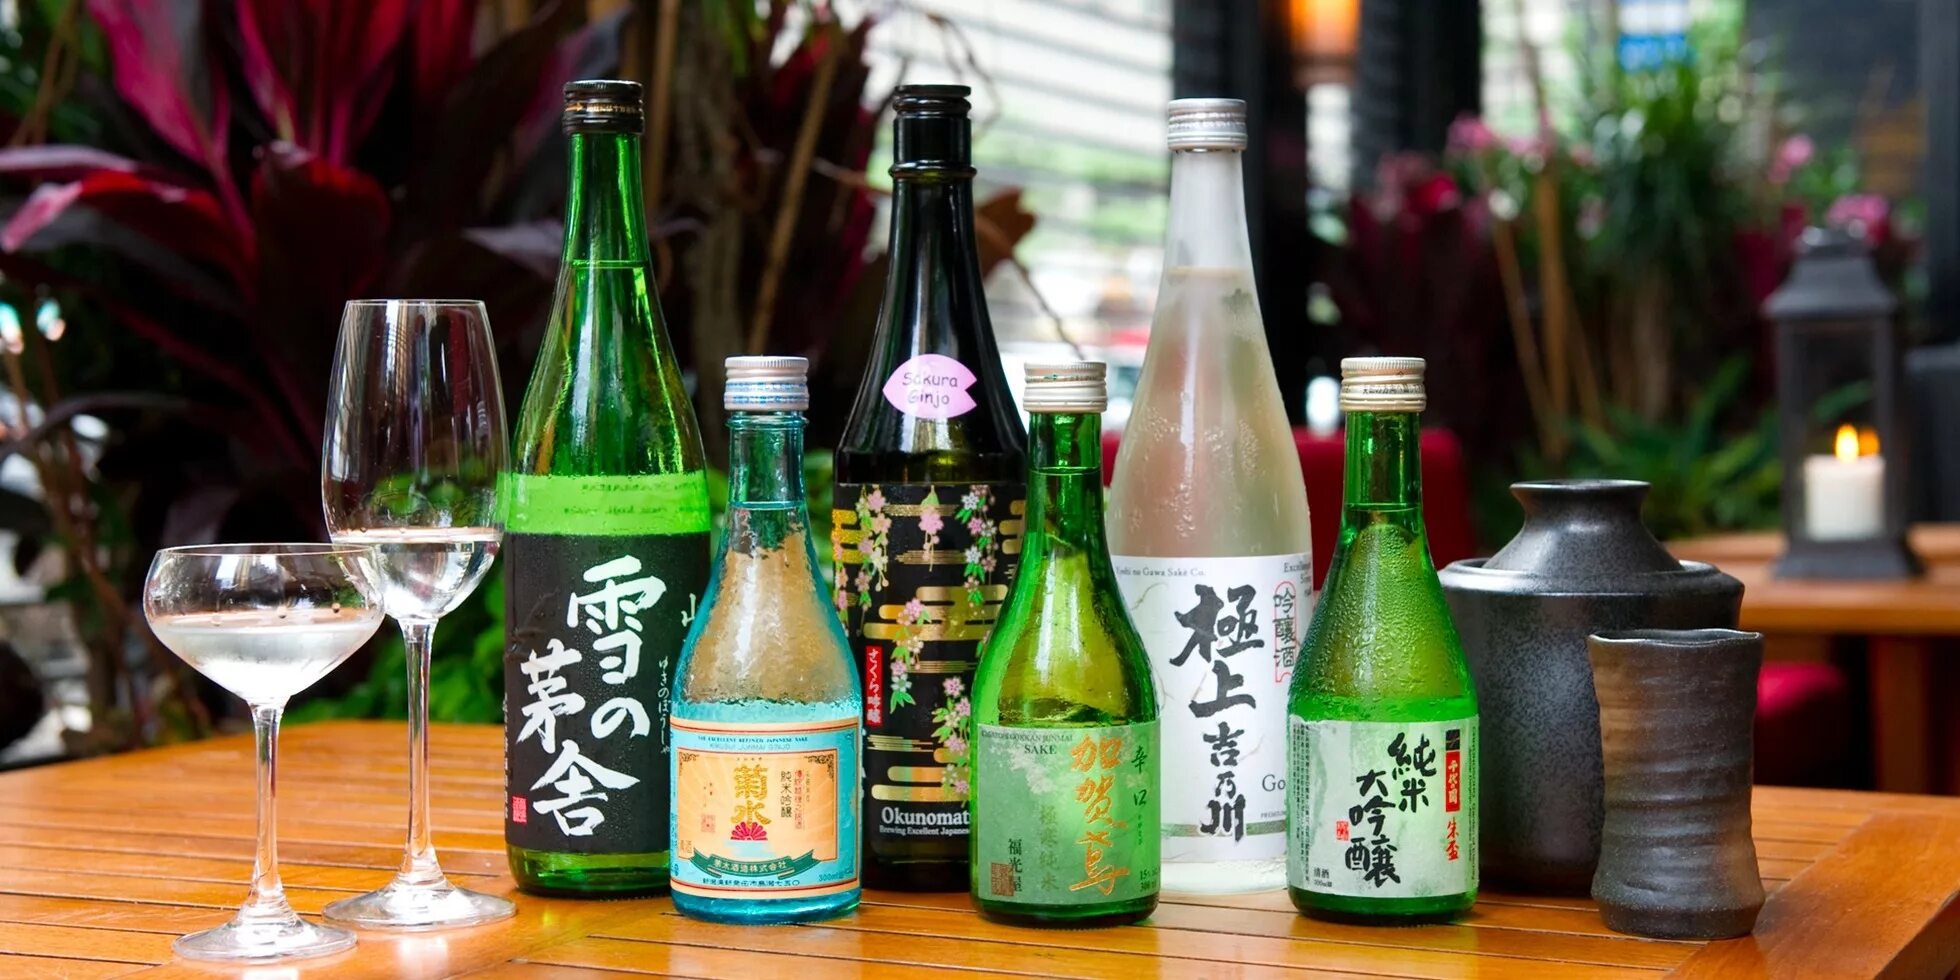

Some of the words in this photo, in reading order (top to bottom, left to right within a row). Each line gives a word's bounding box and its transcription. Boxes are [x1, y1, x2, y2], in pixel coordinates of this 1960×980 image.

[902, 372, 958, 388] Sakura
[908, 389, 950, 409] Ginjo
[1142, 566, 1166, 576] Gawa
[566, 554, 667, 740] 雪の
[1024, 744, 1057, 755] SAKE
[1387, 732, 1437, 813] 純米
[730, 763, 772, 826] 菊水
[879, 825, 907, 836] Brewing
[907, 826, 939, 835] Excellent
